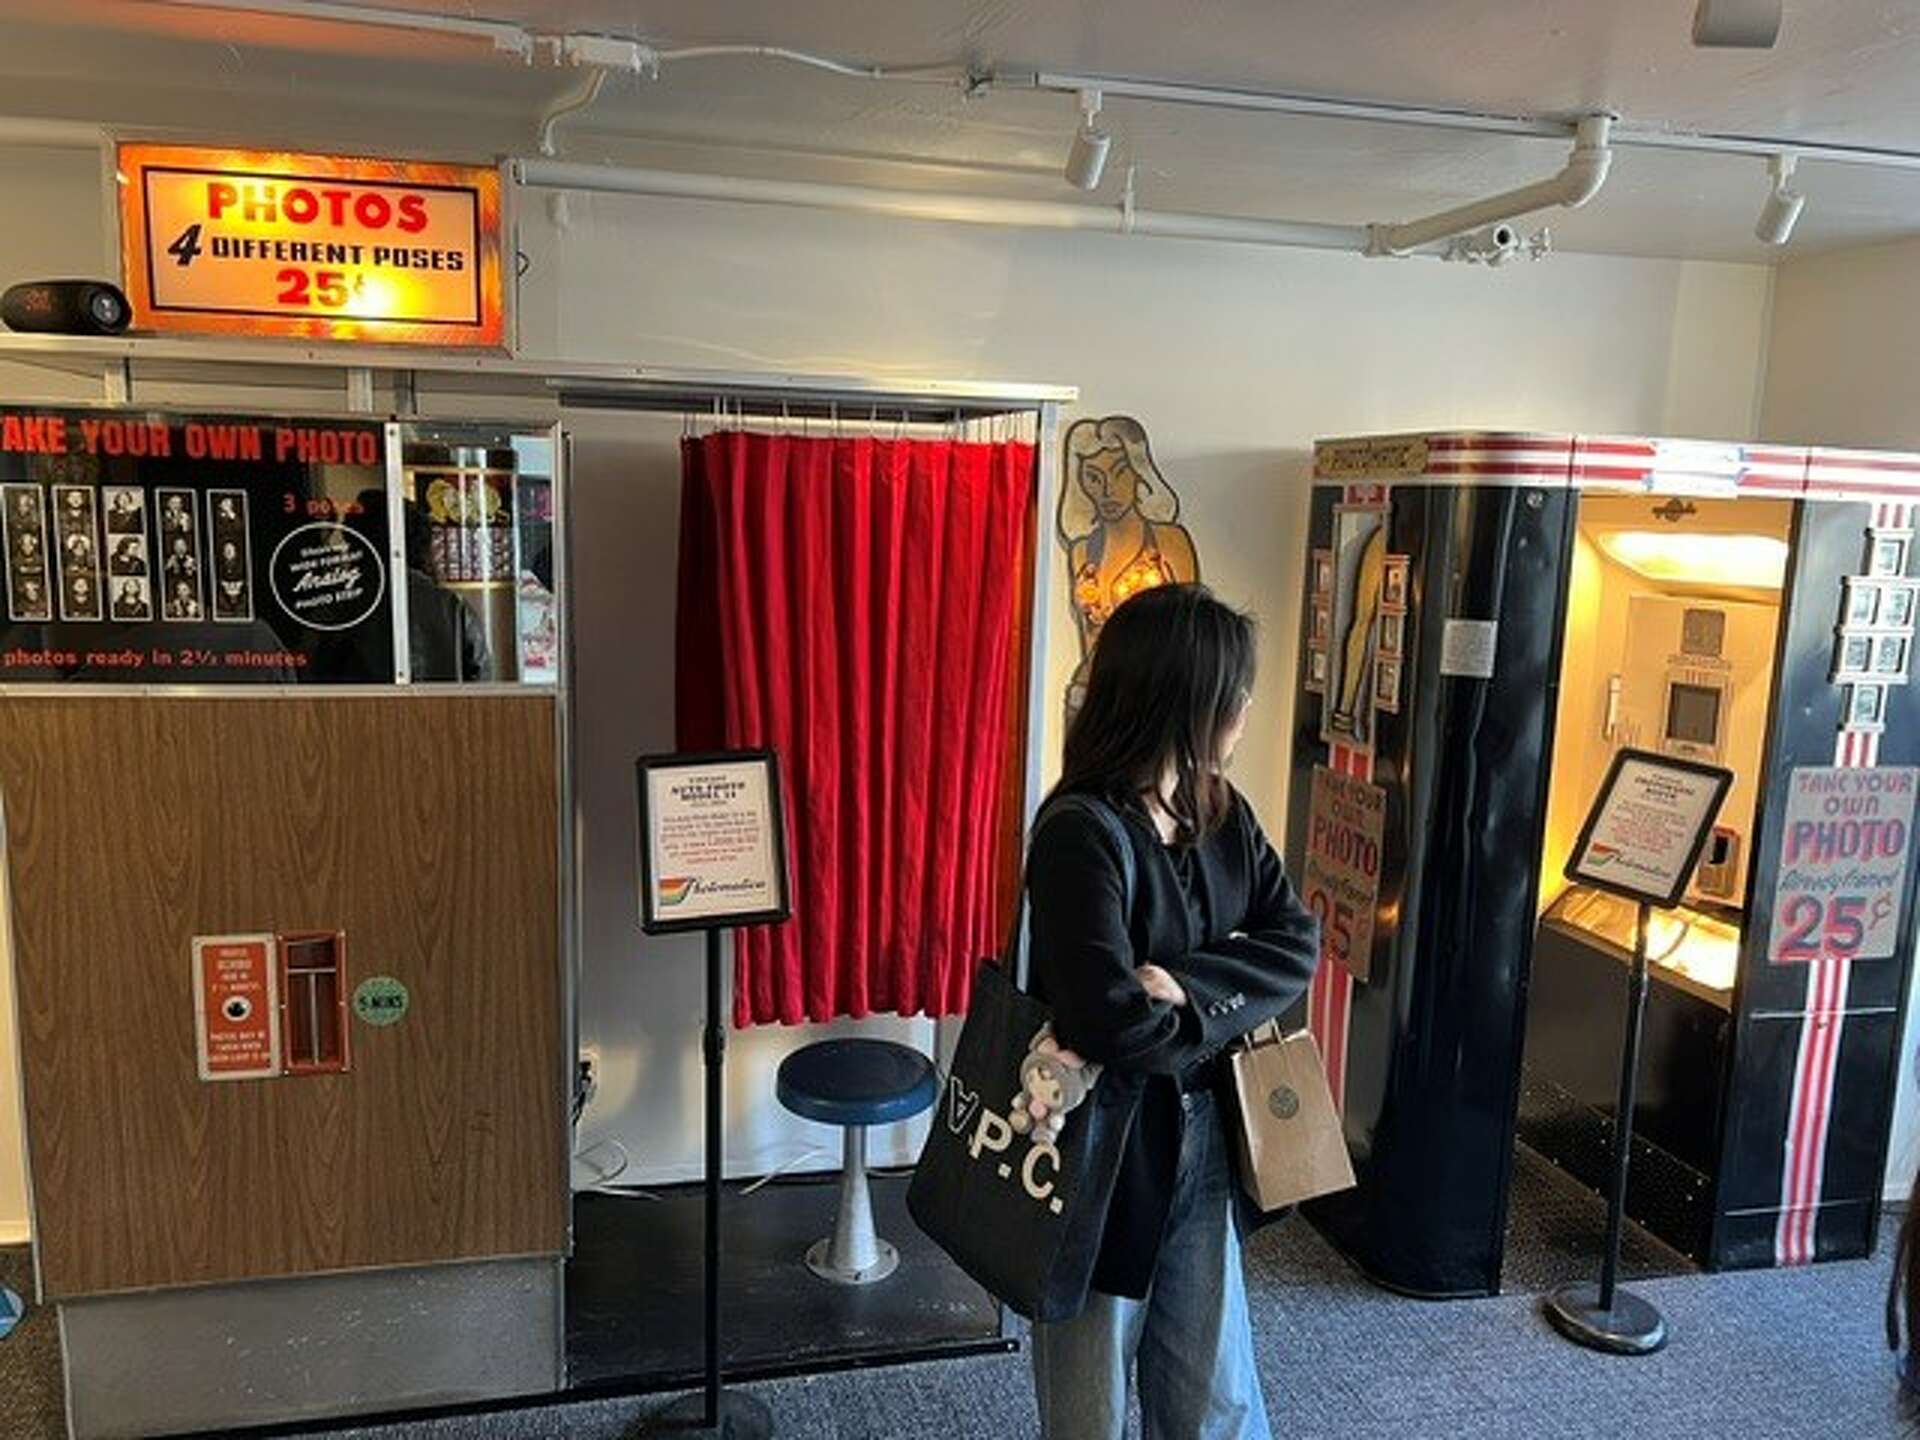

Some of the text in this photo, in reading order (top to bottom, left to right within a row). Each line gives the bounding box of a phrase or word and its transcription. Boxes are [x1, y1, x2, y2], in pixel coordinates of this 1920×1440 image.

[207, 183, 428, 233] PHOTOS
[168, 224, 463, 271] 4 DIFFERENT POSES
[80, 419, 171, 457] YOUR
[185, 423, 261, 460] OWN
[276, 428, 377, 465] PHOTO
[283, 493, 296, 513] 3
[4, 650, 77, 667] photos
[86, 651, 144, 668] ready
[225, 650, 307, 667] minutes
[1855, 771, 1913, 793] YOUR
[1823, 795, 1880, 816] OWN
[1308, 813, 1378, 877] PHOTO
[1784, 819, 1906, 865] PHOTO
